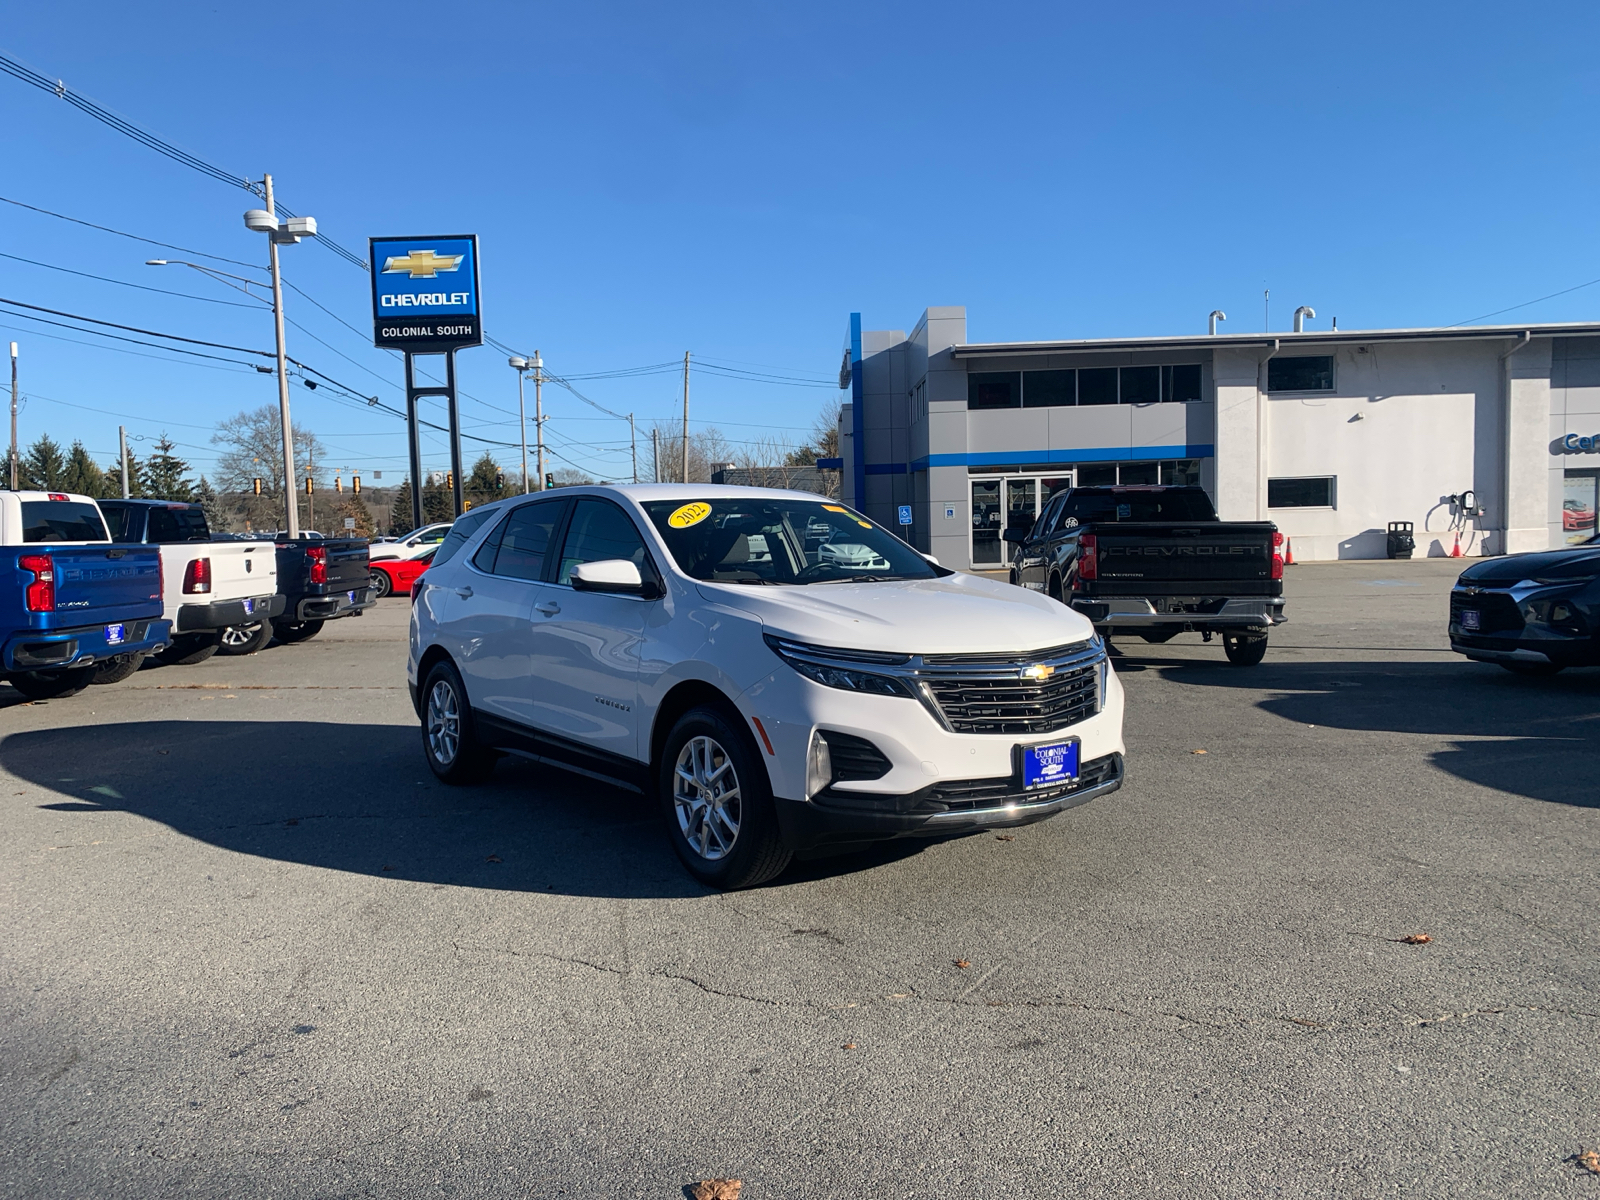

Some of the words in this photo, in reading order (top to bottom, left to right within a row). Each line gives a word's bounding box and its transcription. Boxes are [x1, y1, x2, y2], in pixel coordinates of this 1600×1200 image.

[381, 292, 470, 307] CHEVROLET
[382, 327, 434, 337] COLONIAL
[437, 325, 472, 336] SOUTH
[676, 504, 706, 525] 2022
[1108, 546, 1260, 556] CHEVROLET
[594, 695, 631, 713] EQUINOX
[1034, 746, 1069, 760] COLONIAL
[1040, 754, 1064, 767] SOUTH
